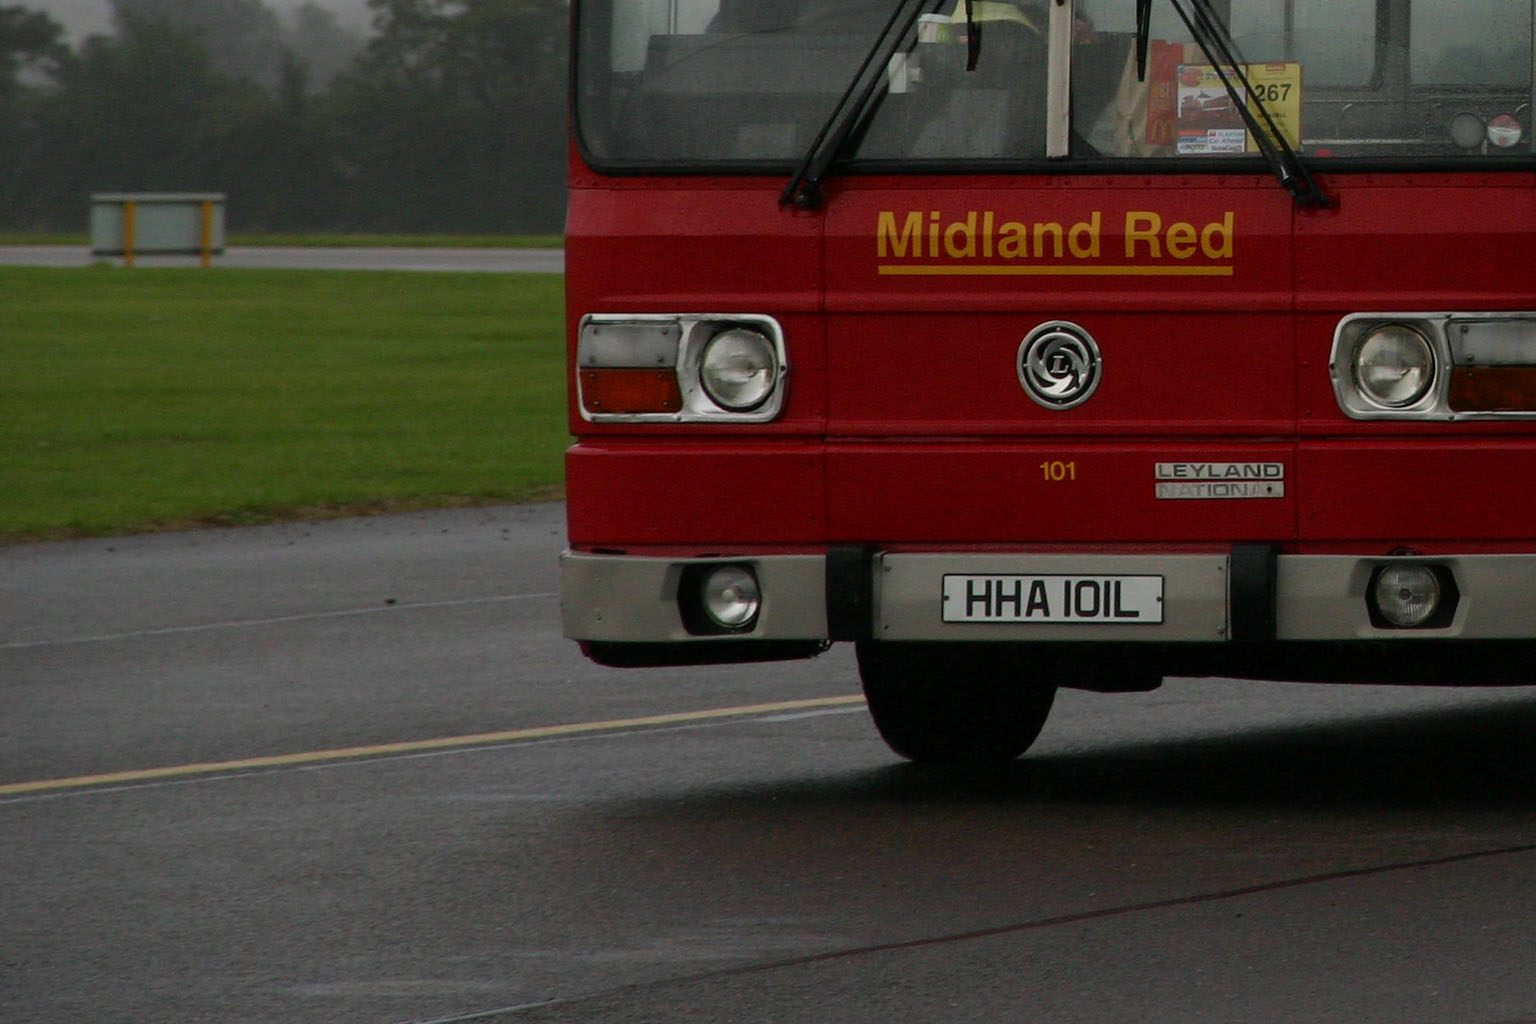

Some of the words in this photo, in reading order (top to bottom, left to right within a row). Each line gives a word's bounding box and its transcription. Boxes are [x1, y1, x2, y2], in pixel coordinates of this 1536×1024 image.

[1255, 84, 1292, 102] 267
[877, 210, 1102, 259] Midland
[1125, 211, 1235, 259] Red
[1040, 461, 1076, 481] 101
[1159, 464, 1281, 478] LEYLAND
[966, 579, 1051, 618] HHA
[1063, 579, 1140, 618] 101L
